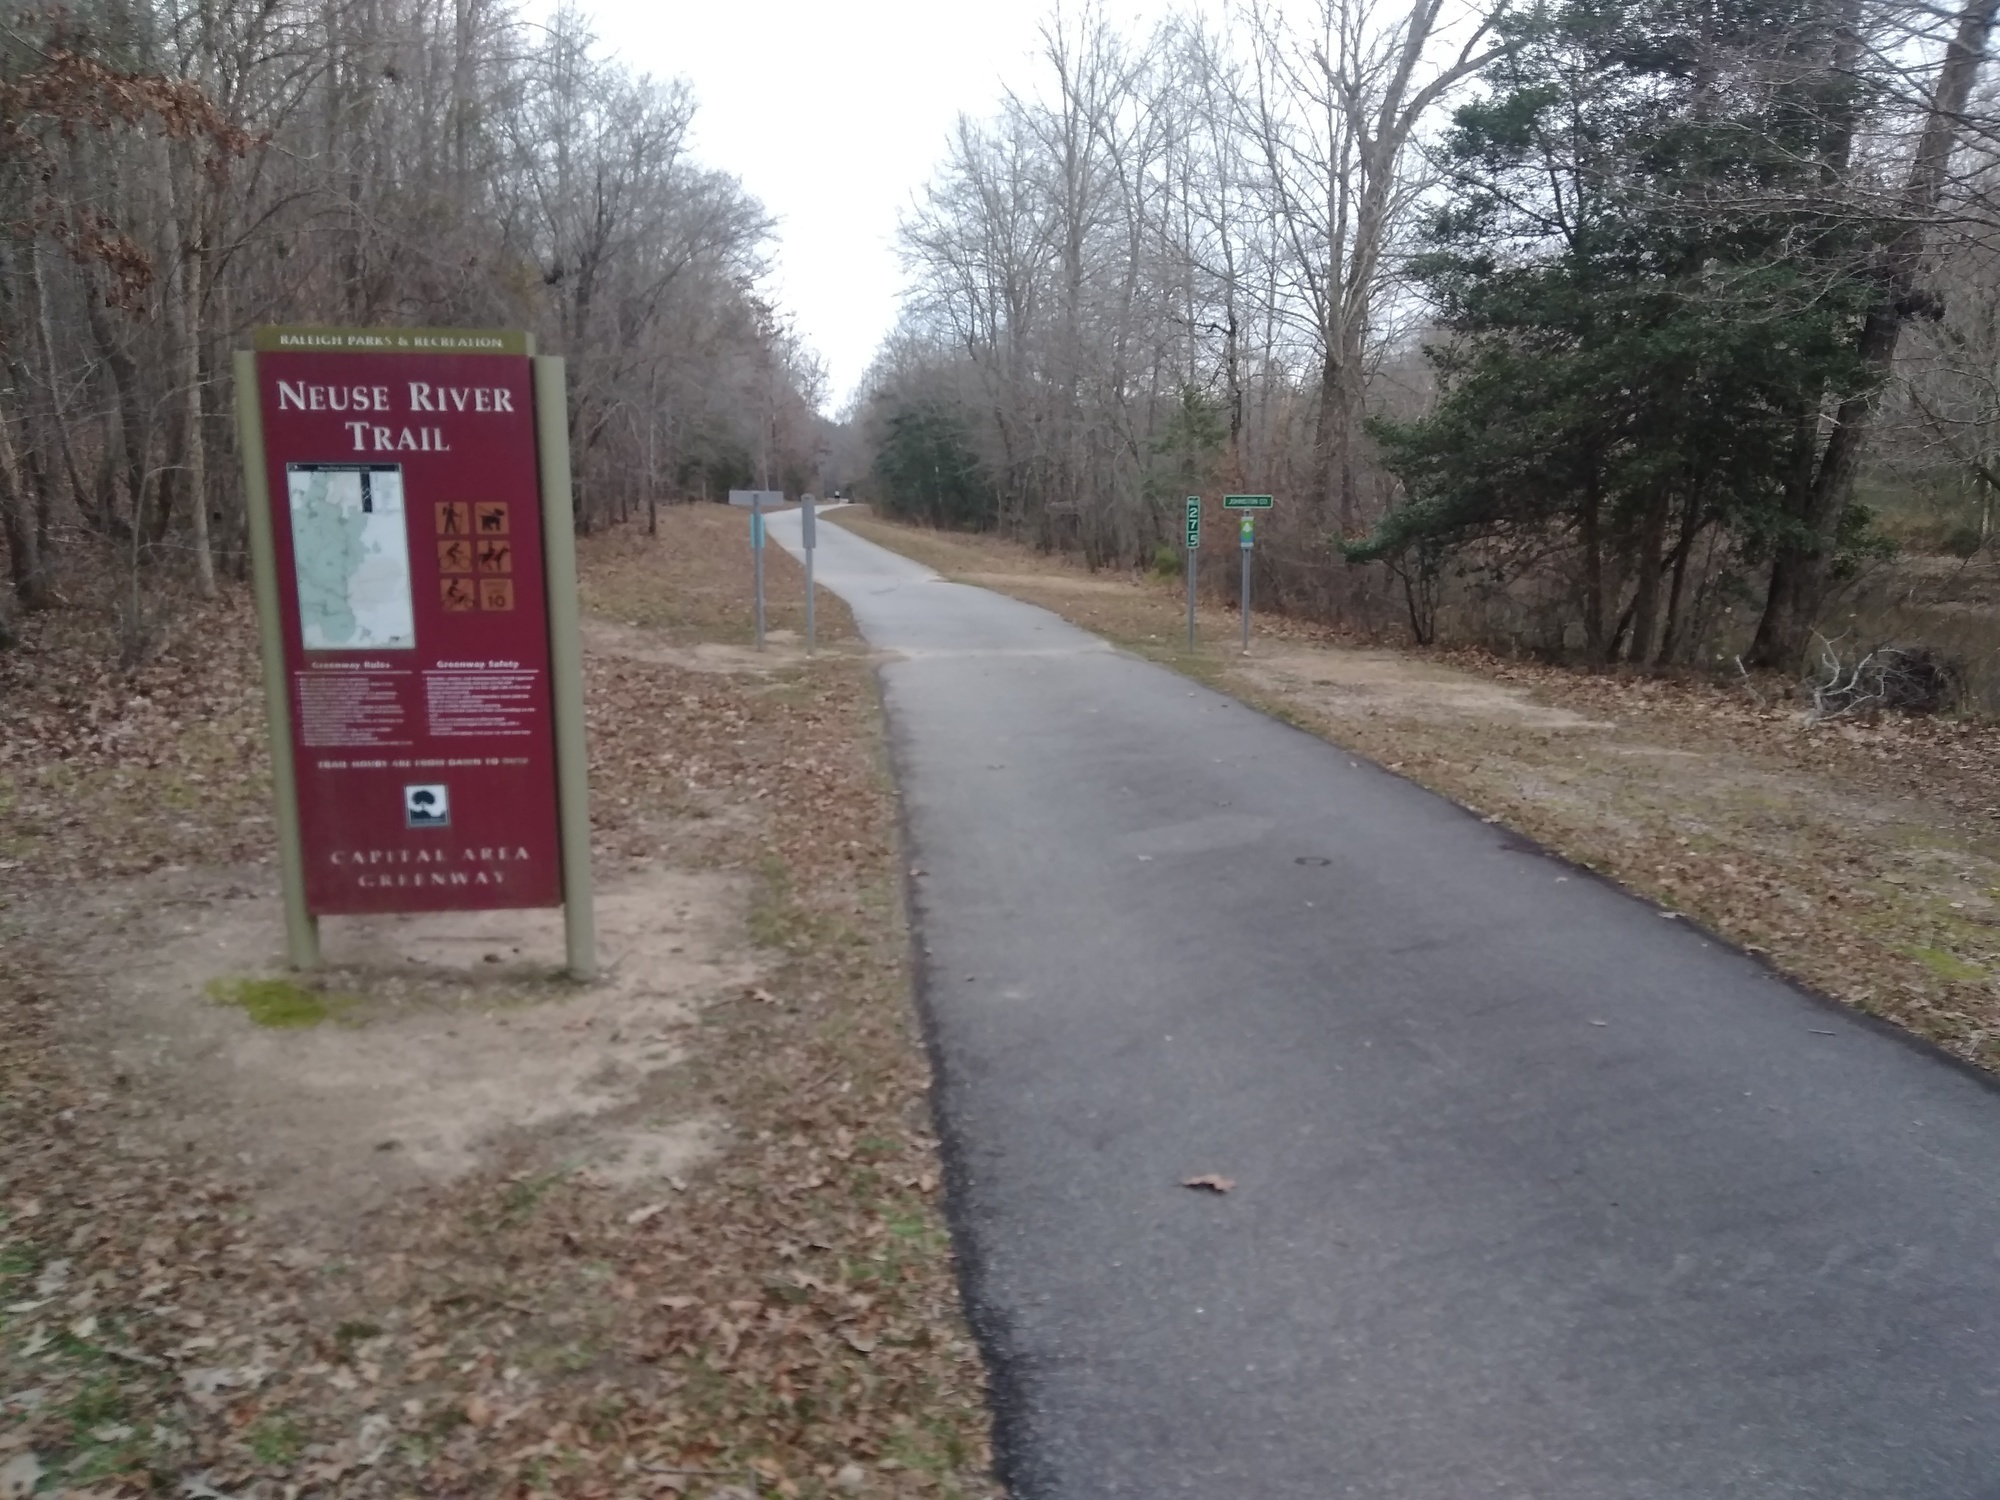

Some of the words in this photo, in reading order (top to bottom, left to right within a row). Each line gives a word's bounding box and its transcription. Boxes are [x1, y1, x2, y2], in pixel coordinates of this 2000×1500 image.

[280, 335, 342, 346] RALEIGH
[348, 335, 392, 347] PARKS
[414, 336, 504, 349] RECREATION
[276, 380, 391, 411] NEUSE
[408, 382, 515, 413] RIVER
[345, 421, 451, 451] TRAIL
[436, 660, 485, 669] Greenway
[488, 660, 520, 669] Safety
[330, 849, 446, 865] CAPITAL
[463, 847, 529, 862] AREA
[358, 871, 505, 888] GREENWAY
